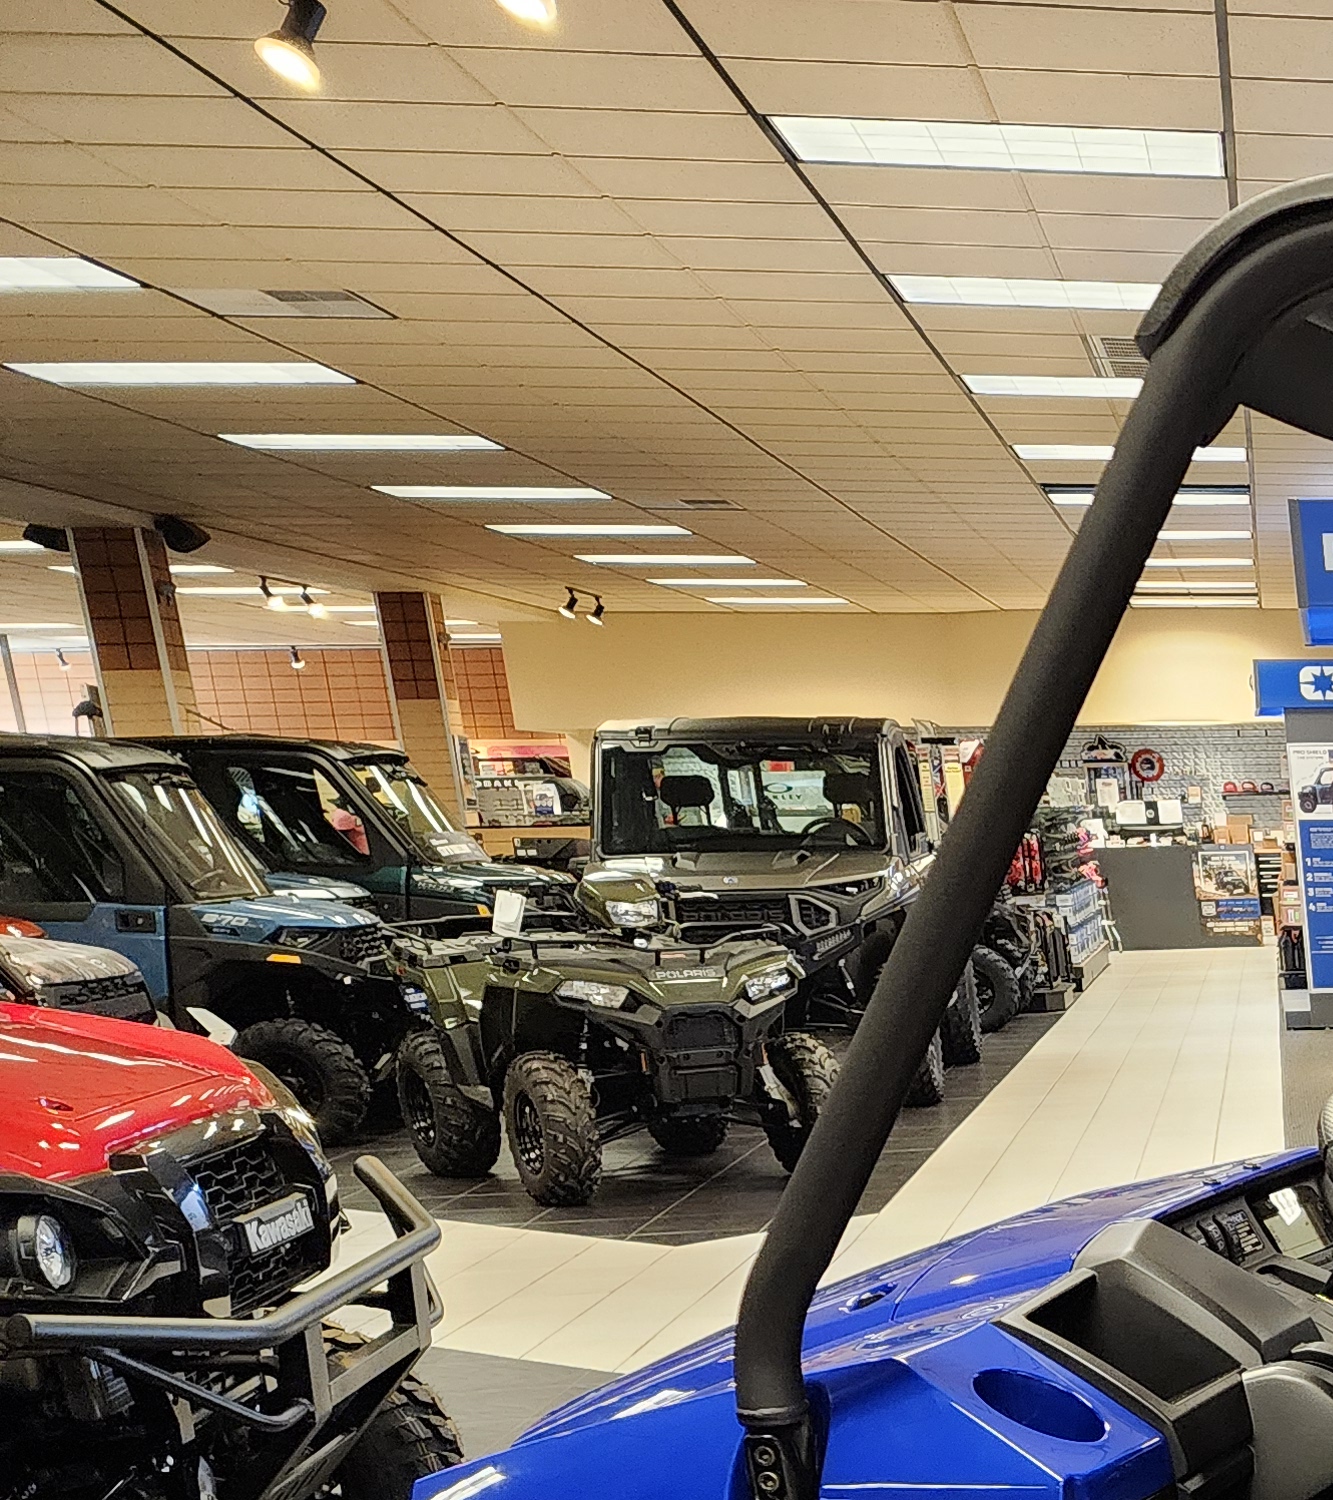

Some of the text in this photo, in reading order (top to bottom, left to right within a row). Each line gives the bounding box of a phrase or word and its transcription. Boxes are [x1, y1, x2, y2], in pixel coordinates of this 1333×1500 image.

[1306, 873, 1313, 882] 2
[655, 969, 717, 980] POLARIS
[245, 1199, 314, 1253] Kawasaki
